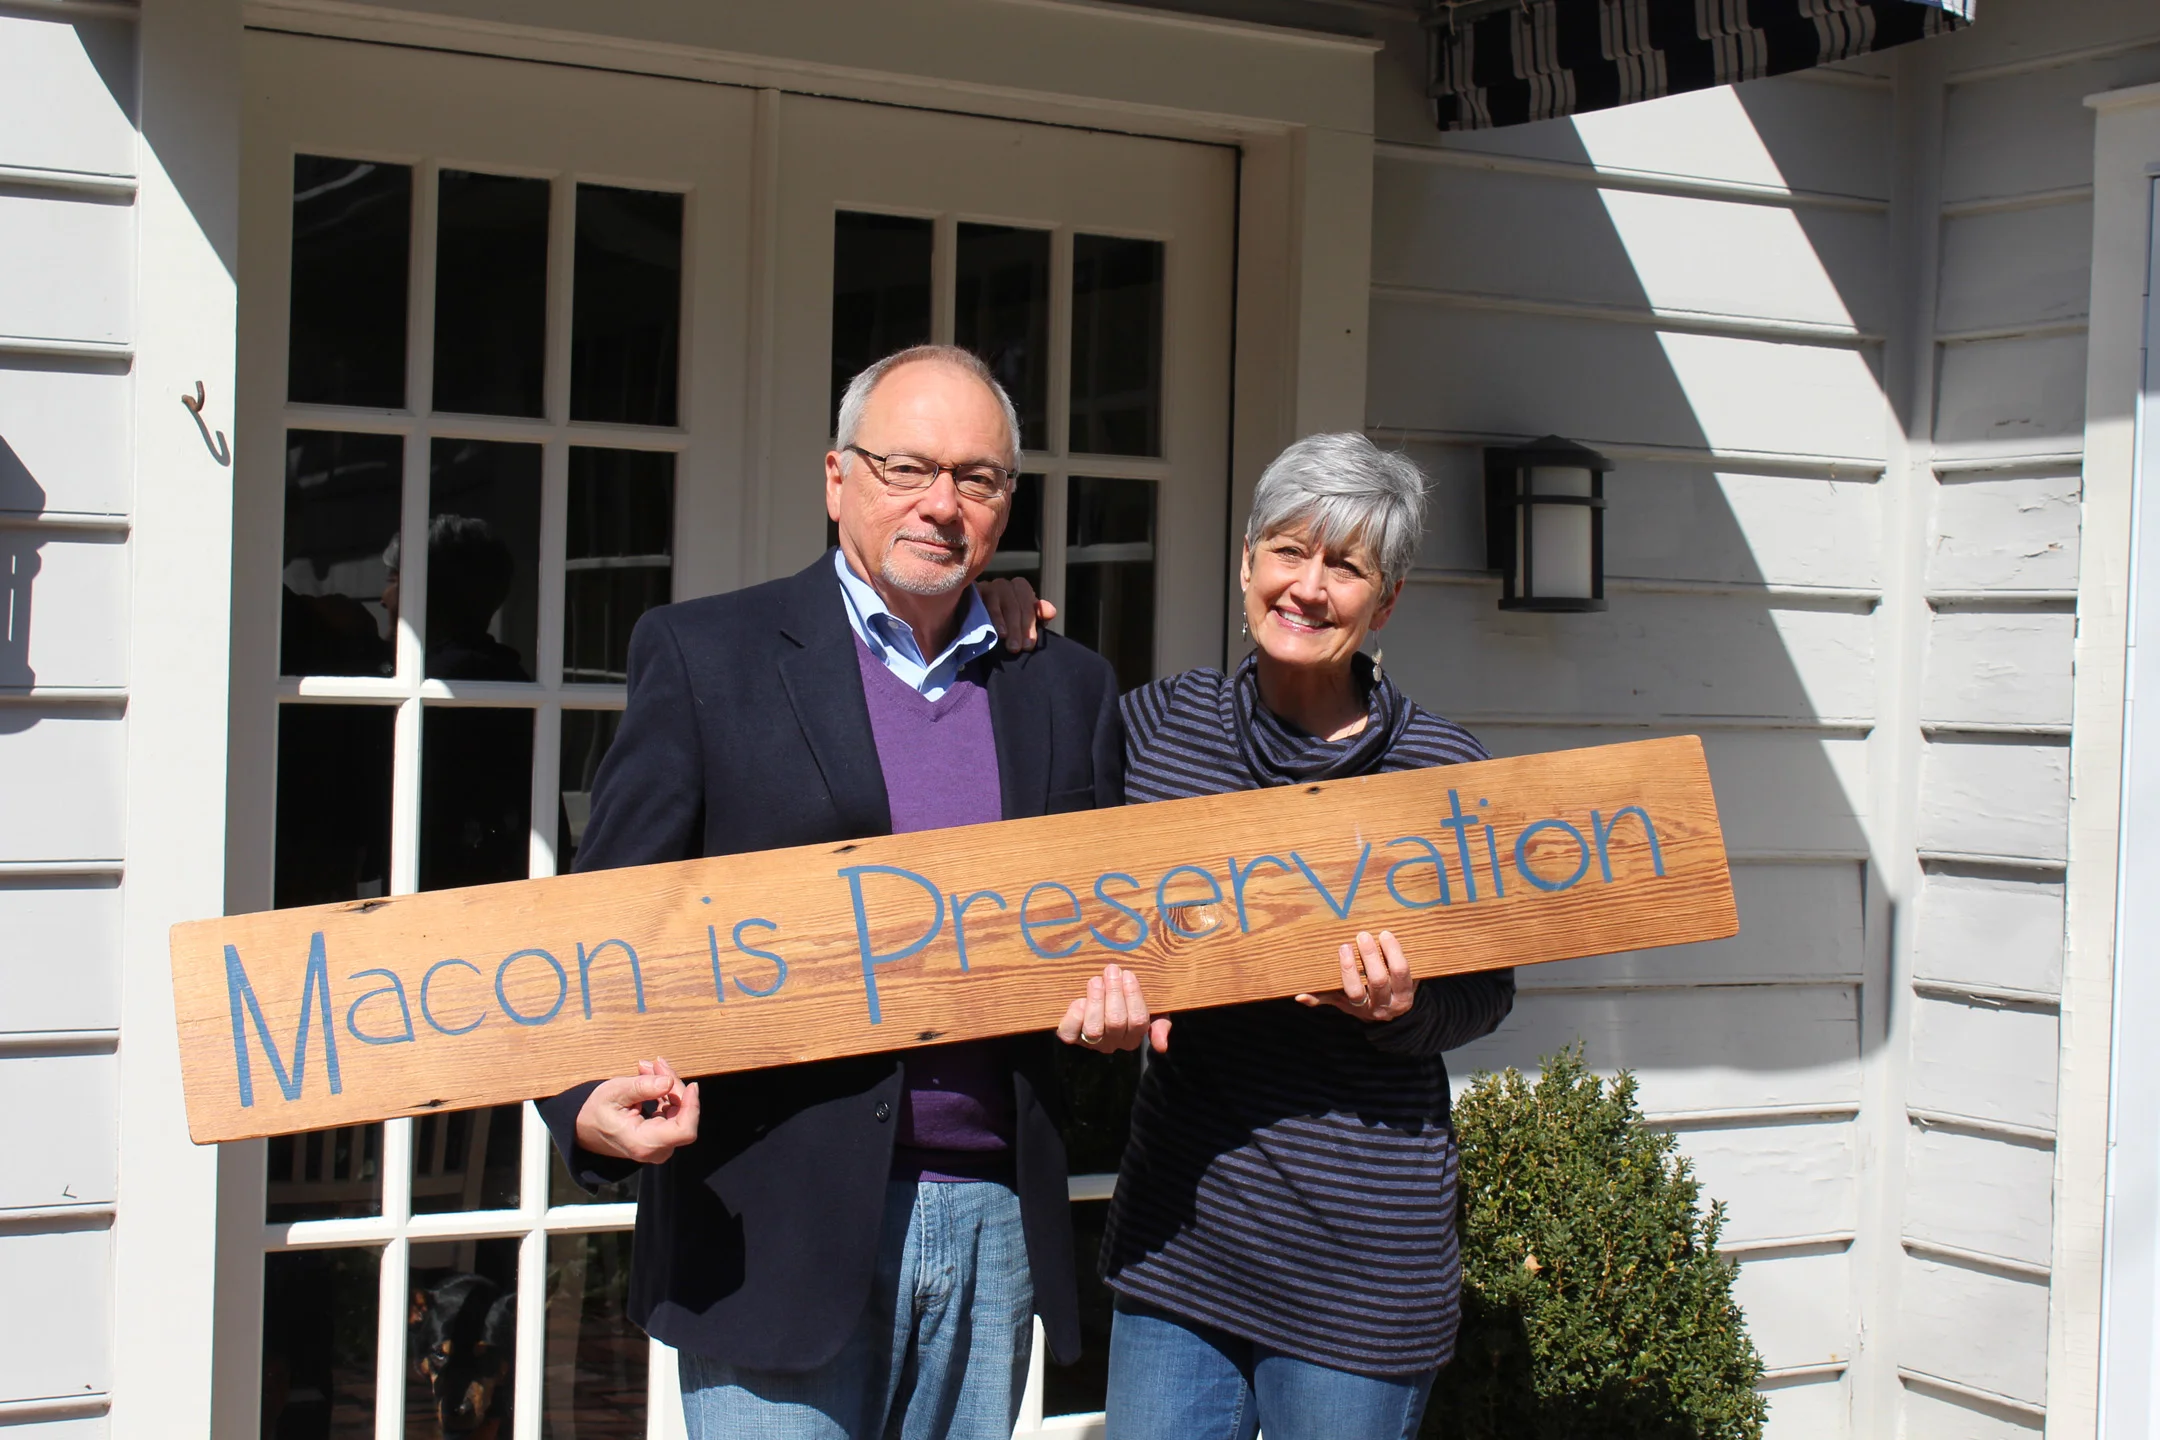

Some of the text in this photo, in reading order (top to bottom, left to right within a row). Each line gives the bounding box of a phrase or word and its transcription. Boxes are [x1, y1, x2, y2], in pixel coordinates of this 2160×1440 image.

[223, 789, 1666, 1108] Macon is Preservation
